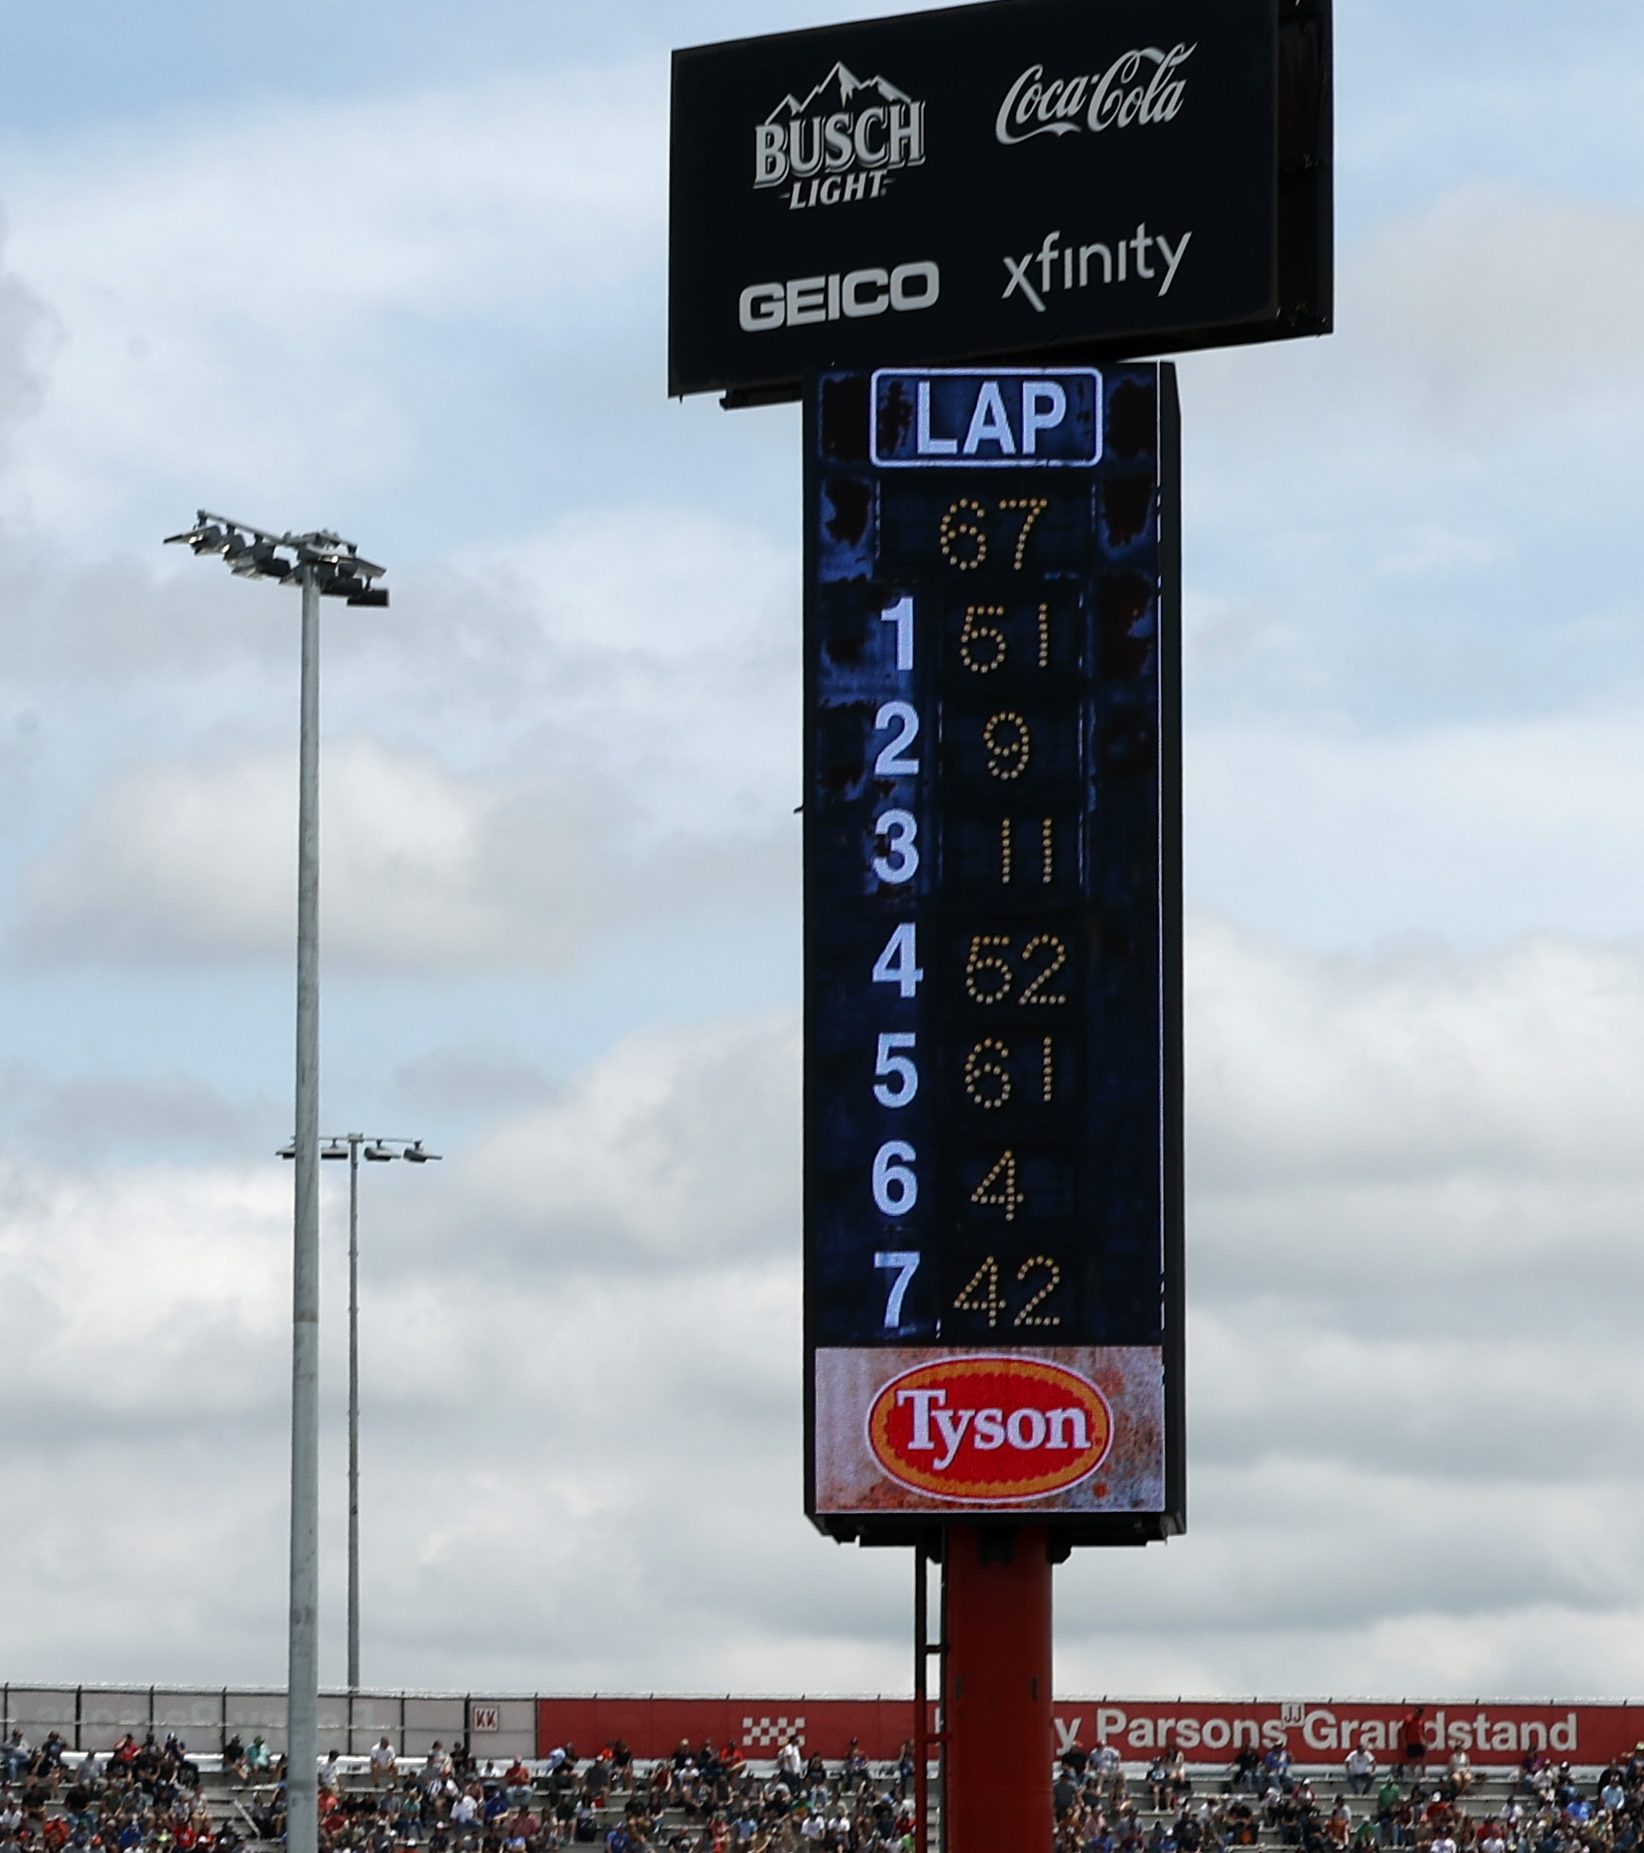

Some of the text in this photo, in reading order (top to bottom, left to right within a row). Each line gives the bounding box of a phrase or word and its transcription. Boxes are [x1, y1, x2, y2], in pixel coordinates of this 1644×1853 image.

[995, 42, 1198, 145] Coca-Cola
[753, 100, 926, 189] BUSCH
[789, 169, 887, 210] LIGHT
[739, 261, 940, 332] GEICO
[1002, 223, 1192, 312] xfinity
[917, 381, 1067, 455] LAP
[940, 498, 1048, 570] 67
[881, 597, 1049, 673] 1 51
[874, 701, 1030, 781] 2 9
[873, 808, 1052, 884] 3 11
[872, 922, 1066, 1004] 4 52
[873, 1032, 1052, 1109] 5 61
[872, 1140, 1024, 1221] 6 4
[874, 1251, 1061, 1328] 7 42
[896, 1389, 1091, 1470] Tyson
[476, 1709, 496, 1728] KK
[1097, 1708, 1288, 1748] Parsons
